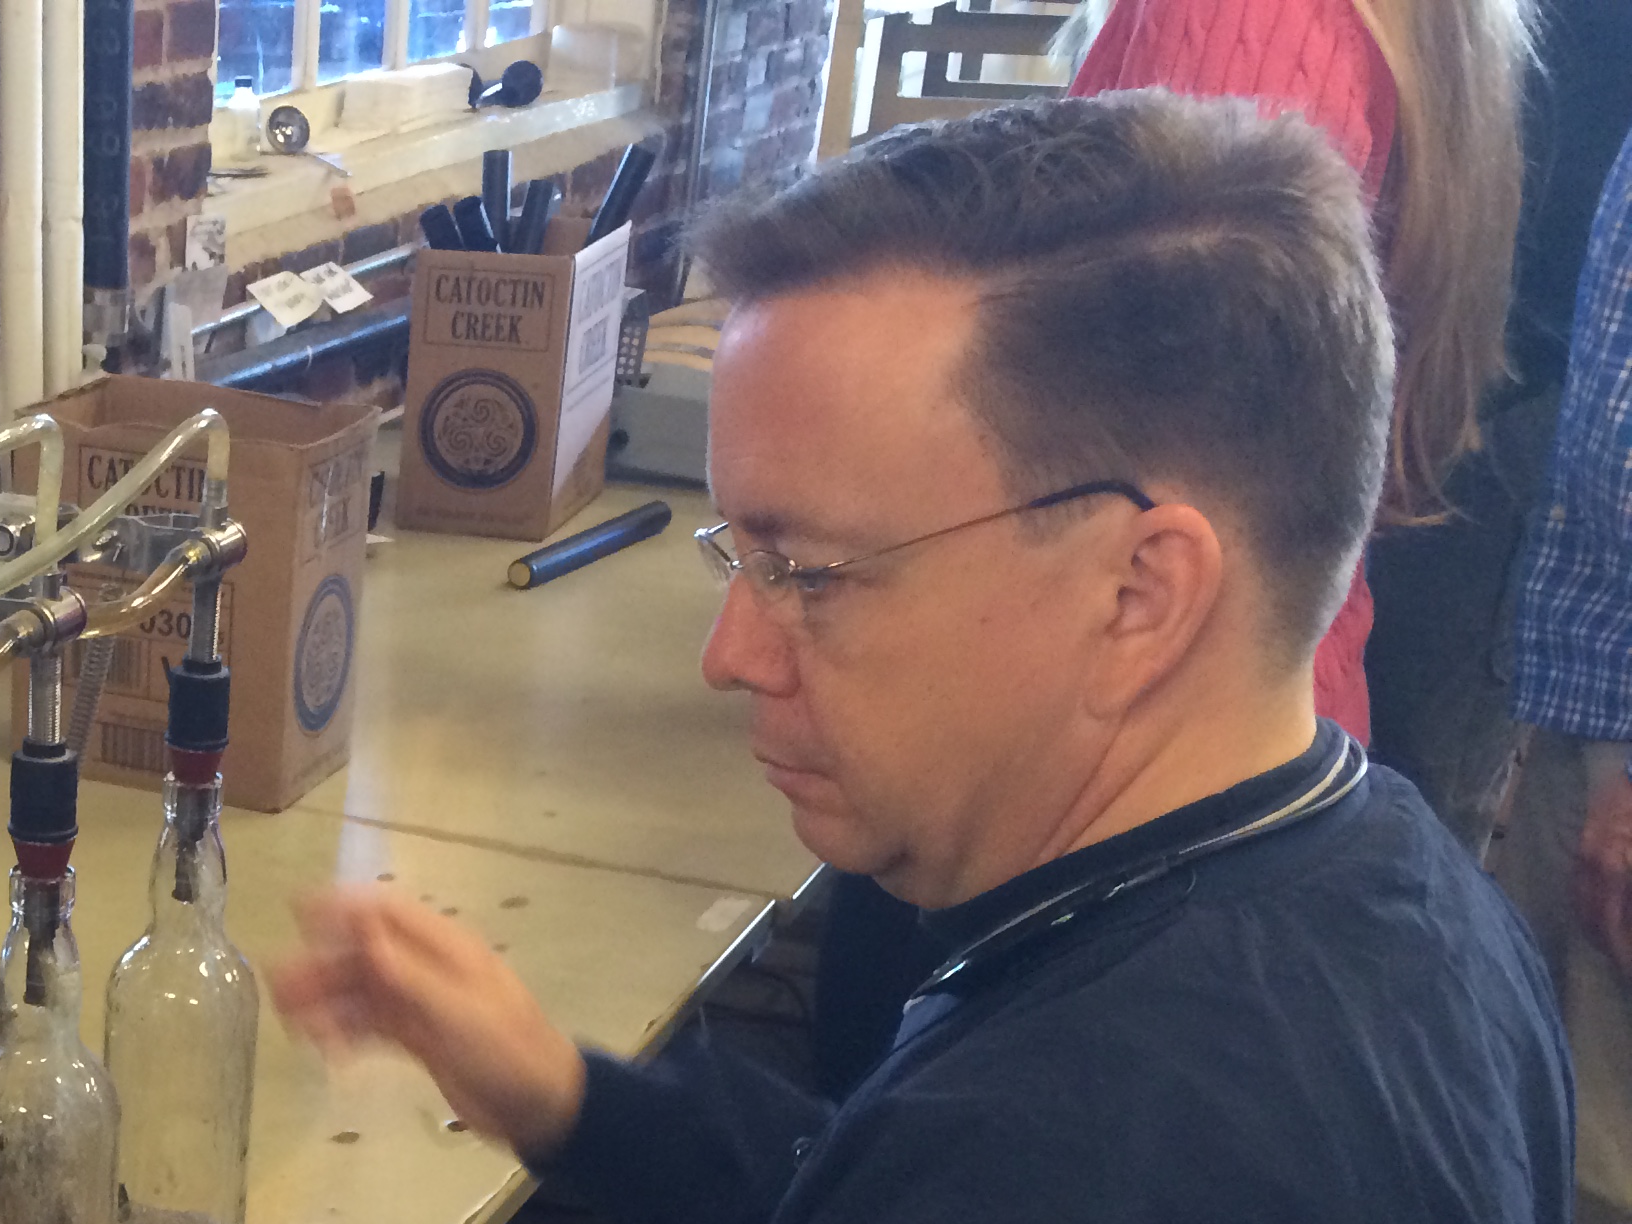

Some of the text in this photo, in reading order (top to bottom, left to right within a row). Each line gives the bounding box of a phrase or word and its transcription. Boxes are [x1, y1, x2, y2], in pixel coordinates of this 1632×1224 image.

[435, 273, 546, 310] CATOCTIN
[451, 310, 523, 344] CREEK
[87, 454, 209, 503] CATCTI
